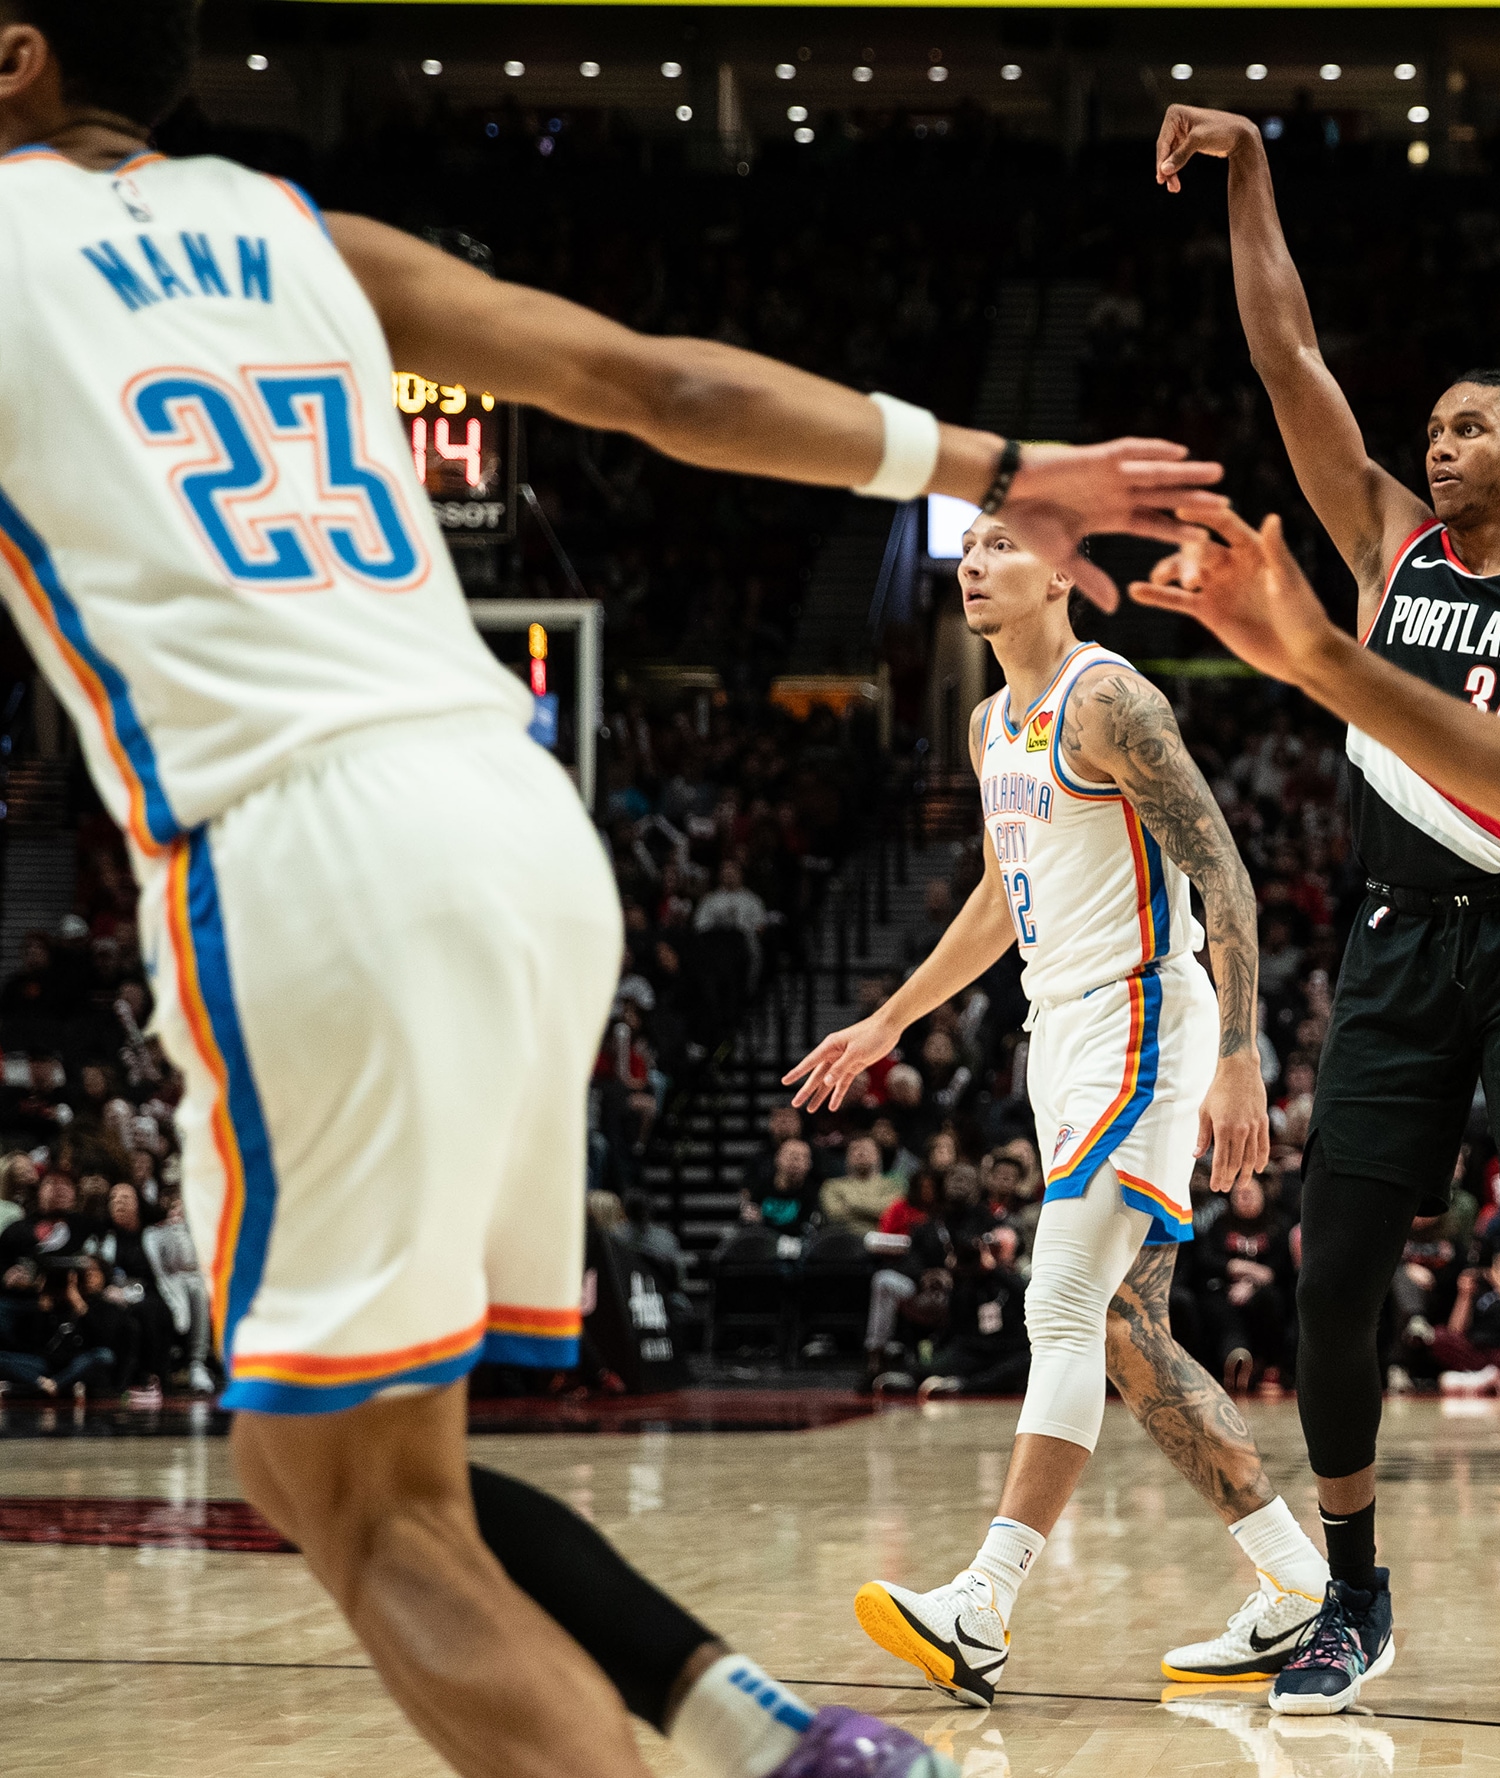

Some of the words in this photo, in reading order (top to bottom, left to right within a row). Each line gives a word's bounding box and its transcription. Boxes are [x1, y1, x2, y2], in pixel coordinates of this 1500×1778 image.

[80, 231, 273, 313] MANN
[121, 362, 430, 593] 23
[412, 416, 482, 487] 14
[981, 772, 1055, 824] KLAHOMA
[995, 821, 1027, 863] CITY
